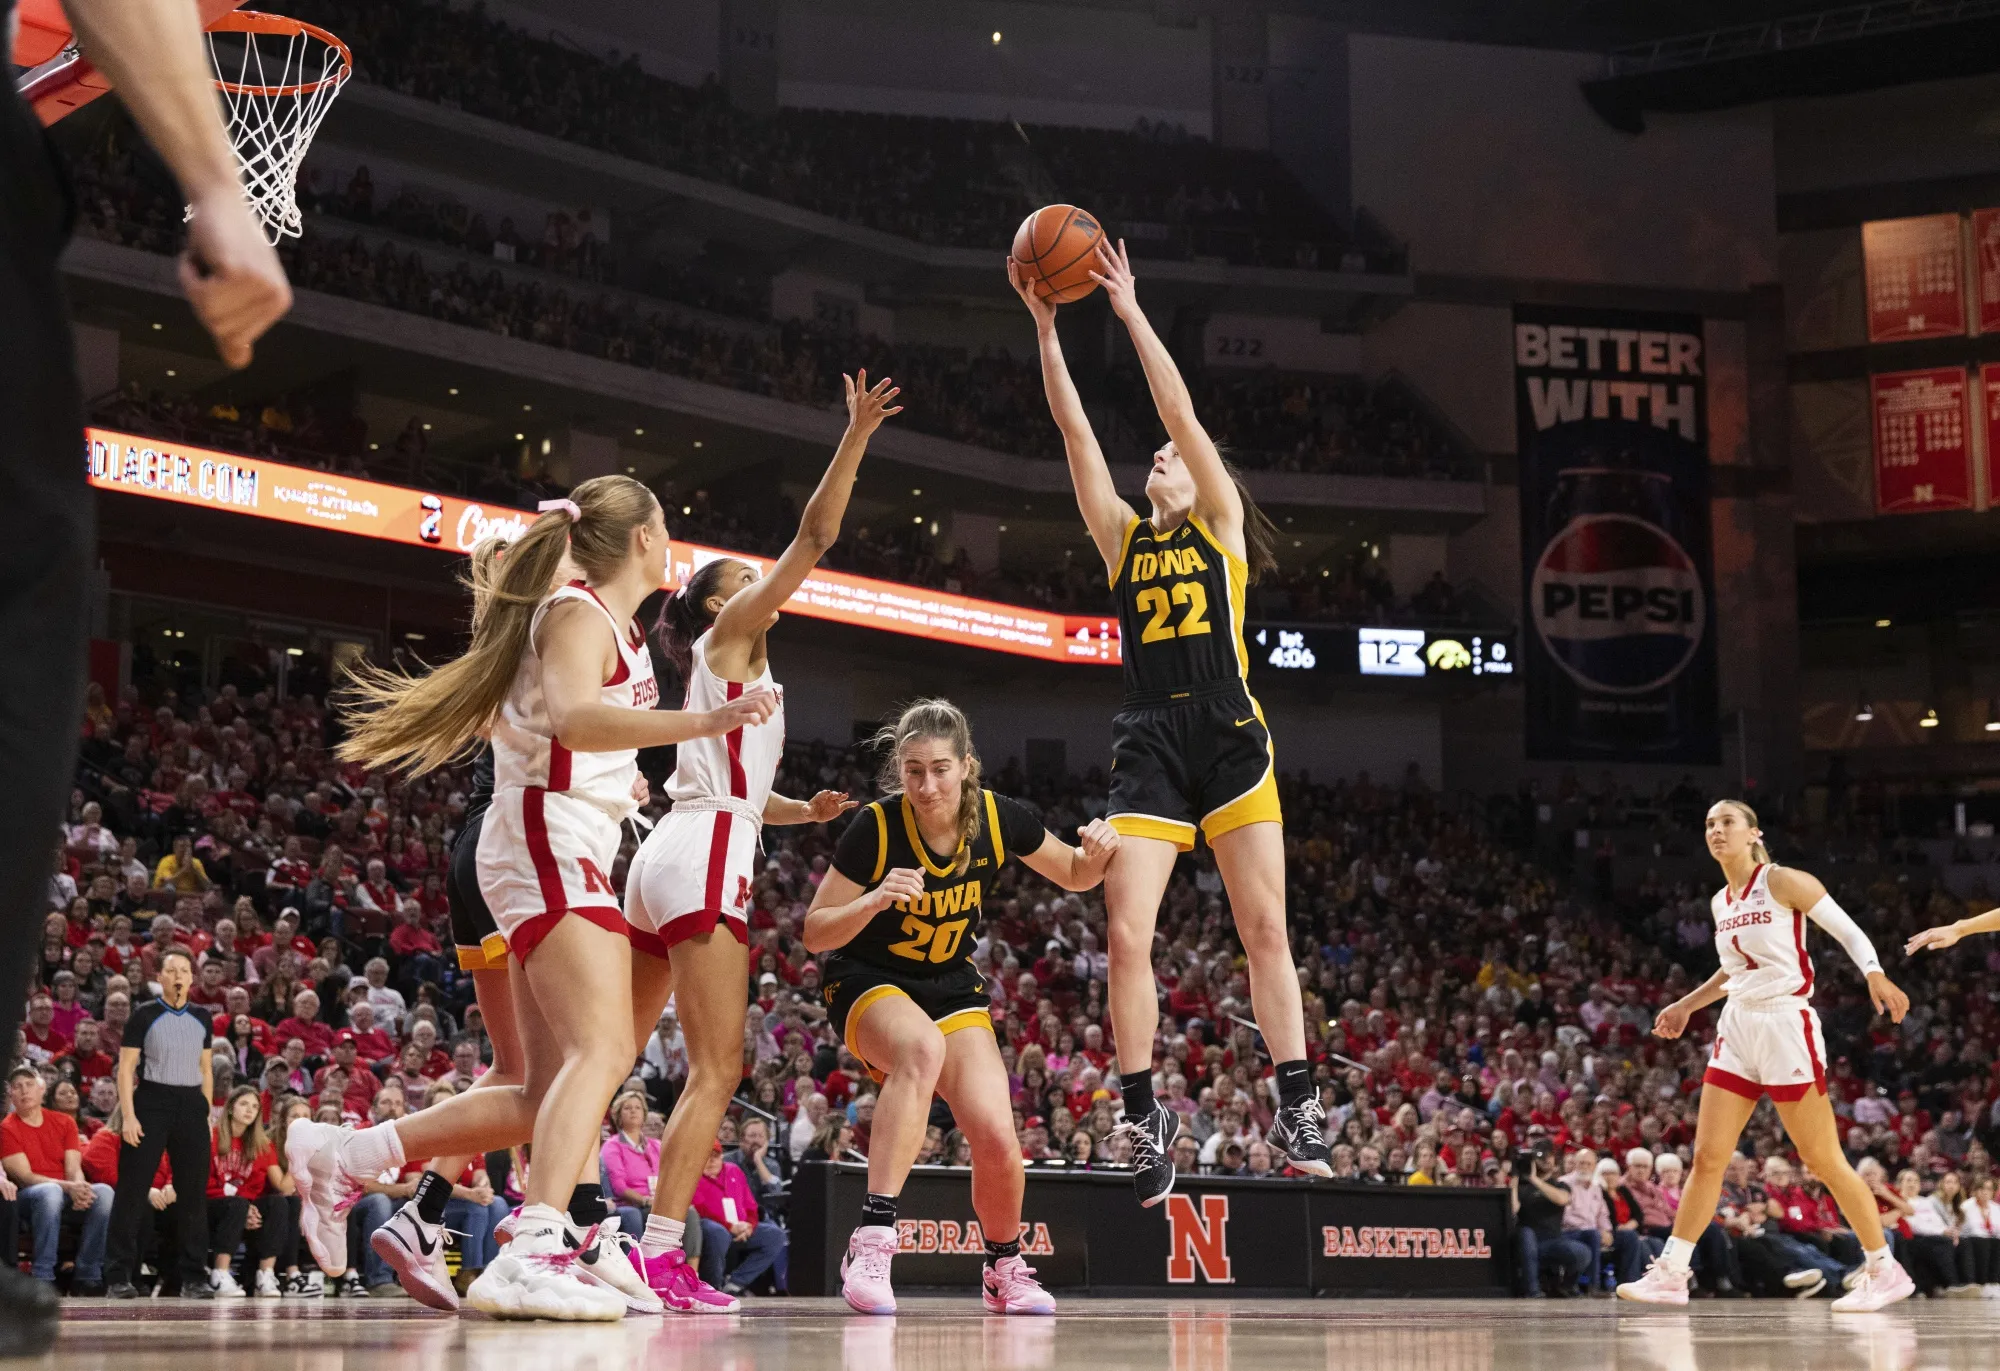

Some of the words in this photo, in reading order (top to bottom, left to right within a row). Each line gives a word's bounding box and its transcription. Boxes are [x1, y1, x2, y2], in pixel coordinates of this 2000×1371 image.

[1218, 336, 1263, 357] 222
[1516, 323, 1701, 377] BETTER
[1526, 376, 1697, 442] WITH
[1131, 546, 1208, 583] IOWA
[1136, 581, 1211, 644] 22
[1543, 582, 1694, 623] PEPSI
[1076, 627, 1090, 643] 4
[1373, 640, 1401, 665] 12
[1491, 642, 1506, 661] 0
[1269, 647, 1316, 669] 4:06
[888, 914, 970, 964] 20
[1731, 935, 1759, 970] 1
[1166, 1193, 1231, 1284] N
[1321, 1226, 1492, 1259] BASKETBALL
